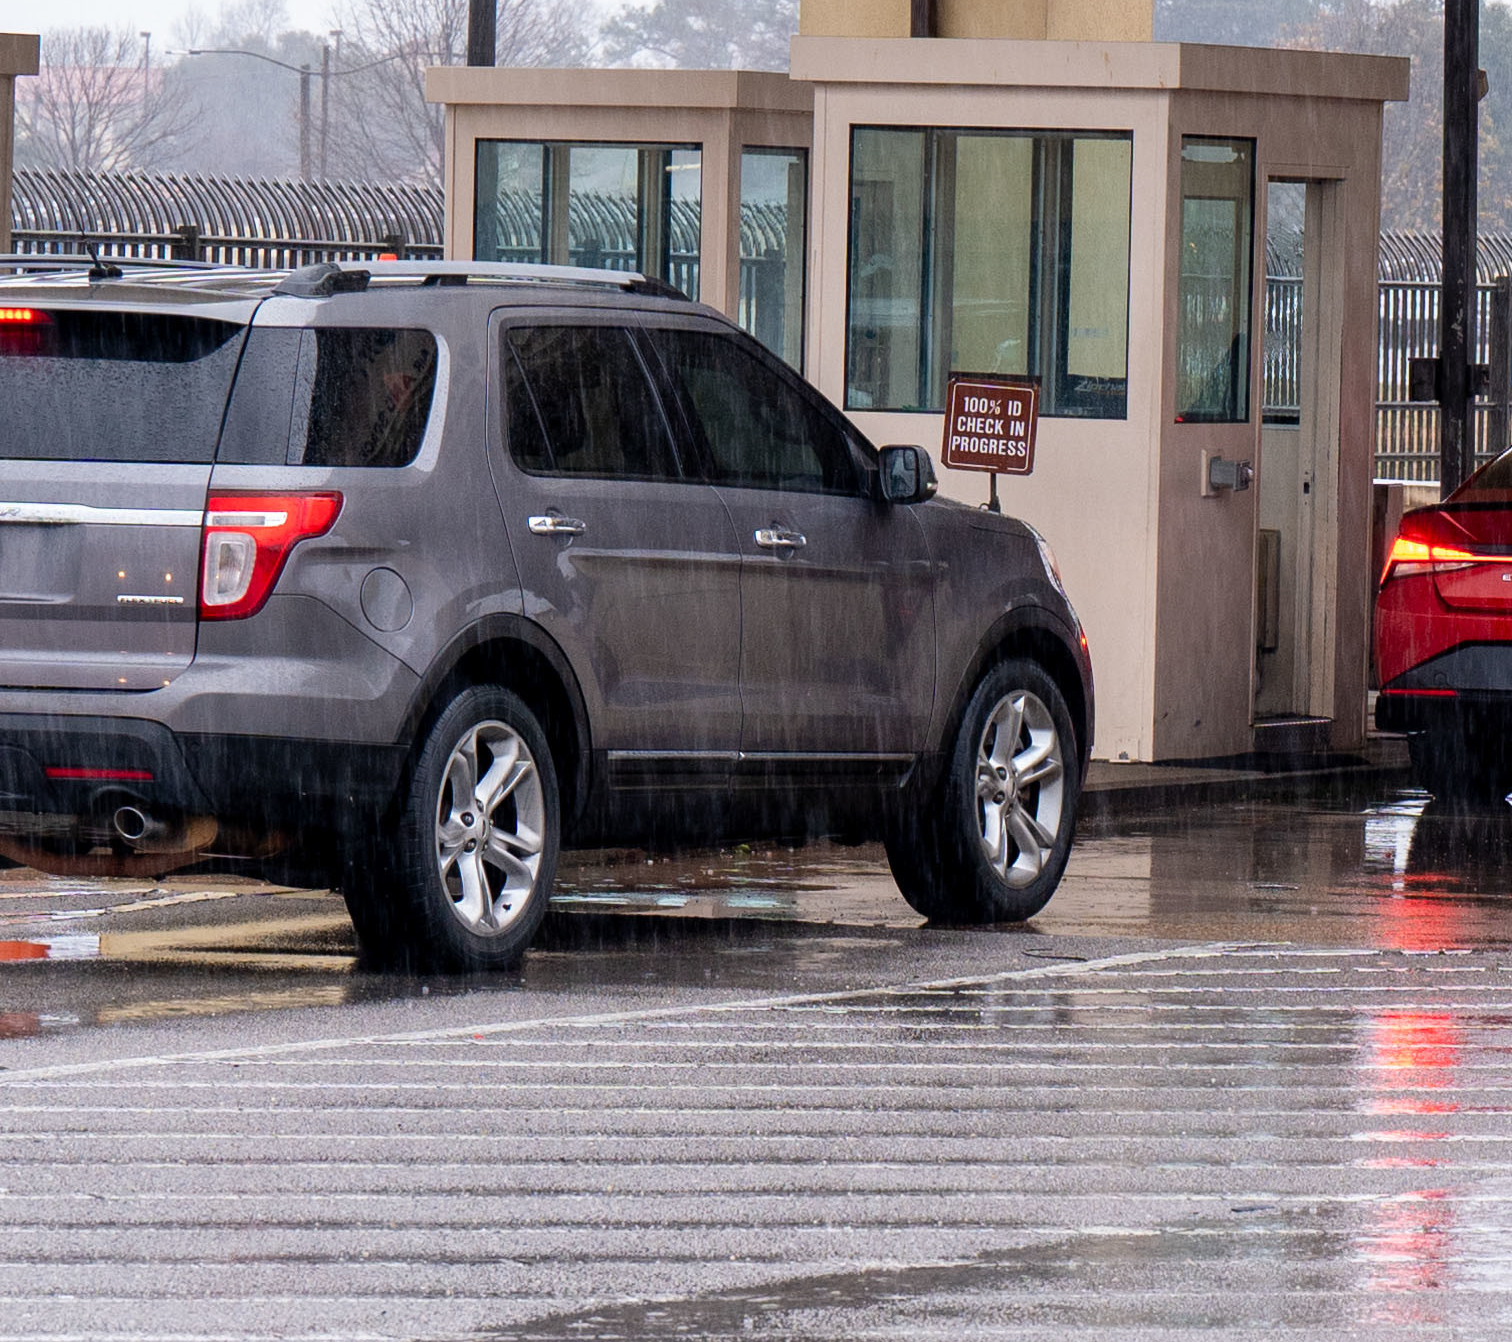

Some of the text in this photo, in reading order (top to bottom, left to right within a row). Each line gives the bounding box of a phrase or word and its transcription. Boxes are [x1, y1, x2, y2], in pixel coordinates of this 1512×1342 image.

[963, 397, 1022, 416] 100% ID
[957, 416, 1025, 437] CHECK IN
[951, 436, 1026, 457] PROGRESS
